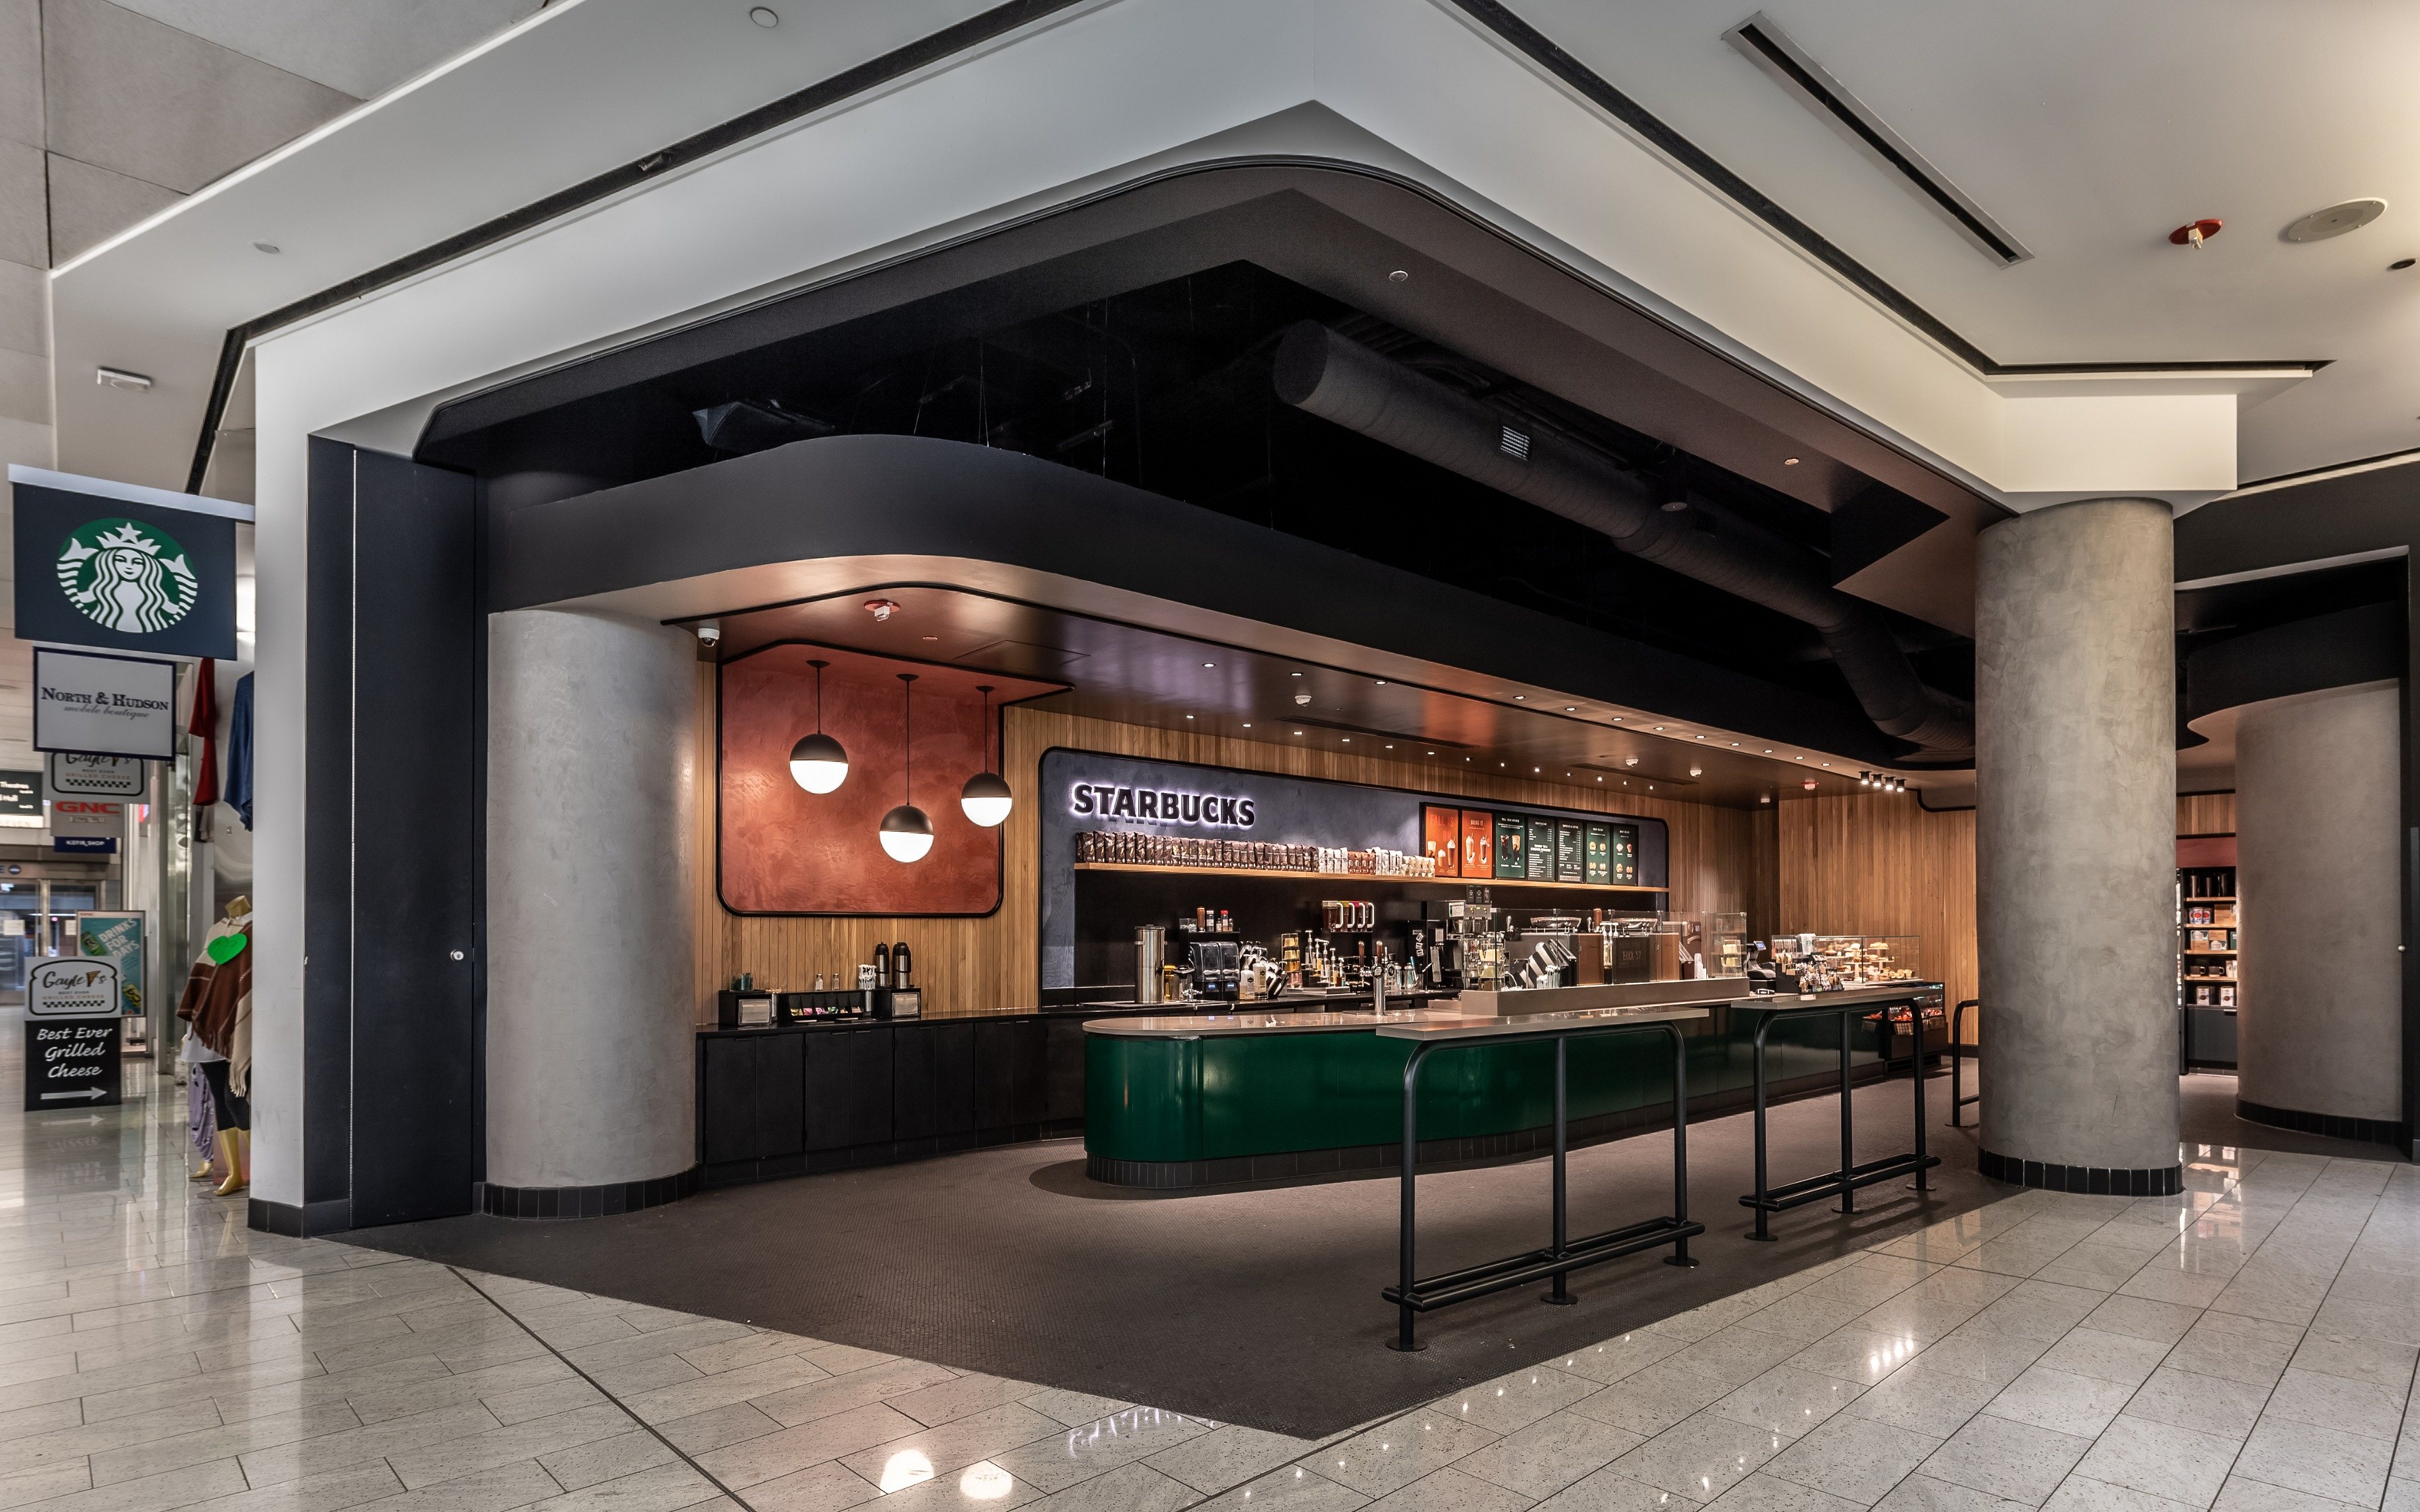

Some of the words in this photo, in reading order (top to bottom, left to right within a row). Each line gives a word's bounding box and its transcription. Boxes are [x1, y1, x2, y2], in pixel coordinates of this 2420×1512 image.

[95, 692, 109, 705] &
[63, 704, 101, 714] mobile
[103, 706, 149, 720] boutique
[55, 801, 121, 814] GNC
[1073, 784, 1255, 826] STARBUCKS
[1430, 814, 1445, 827] FALL
[98, 918, 138, 942] DRINKS
[105, 935, 129, 951] FOR
[112, 940, 140, 956] DAYS
[36, 1028, 72, 1040] Best
[75, 1027, 113, 1039] Ever
[44, 1042, 106, 1061] Grilled
[48, 1063, 103, 1078] Cheese
